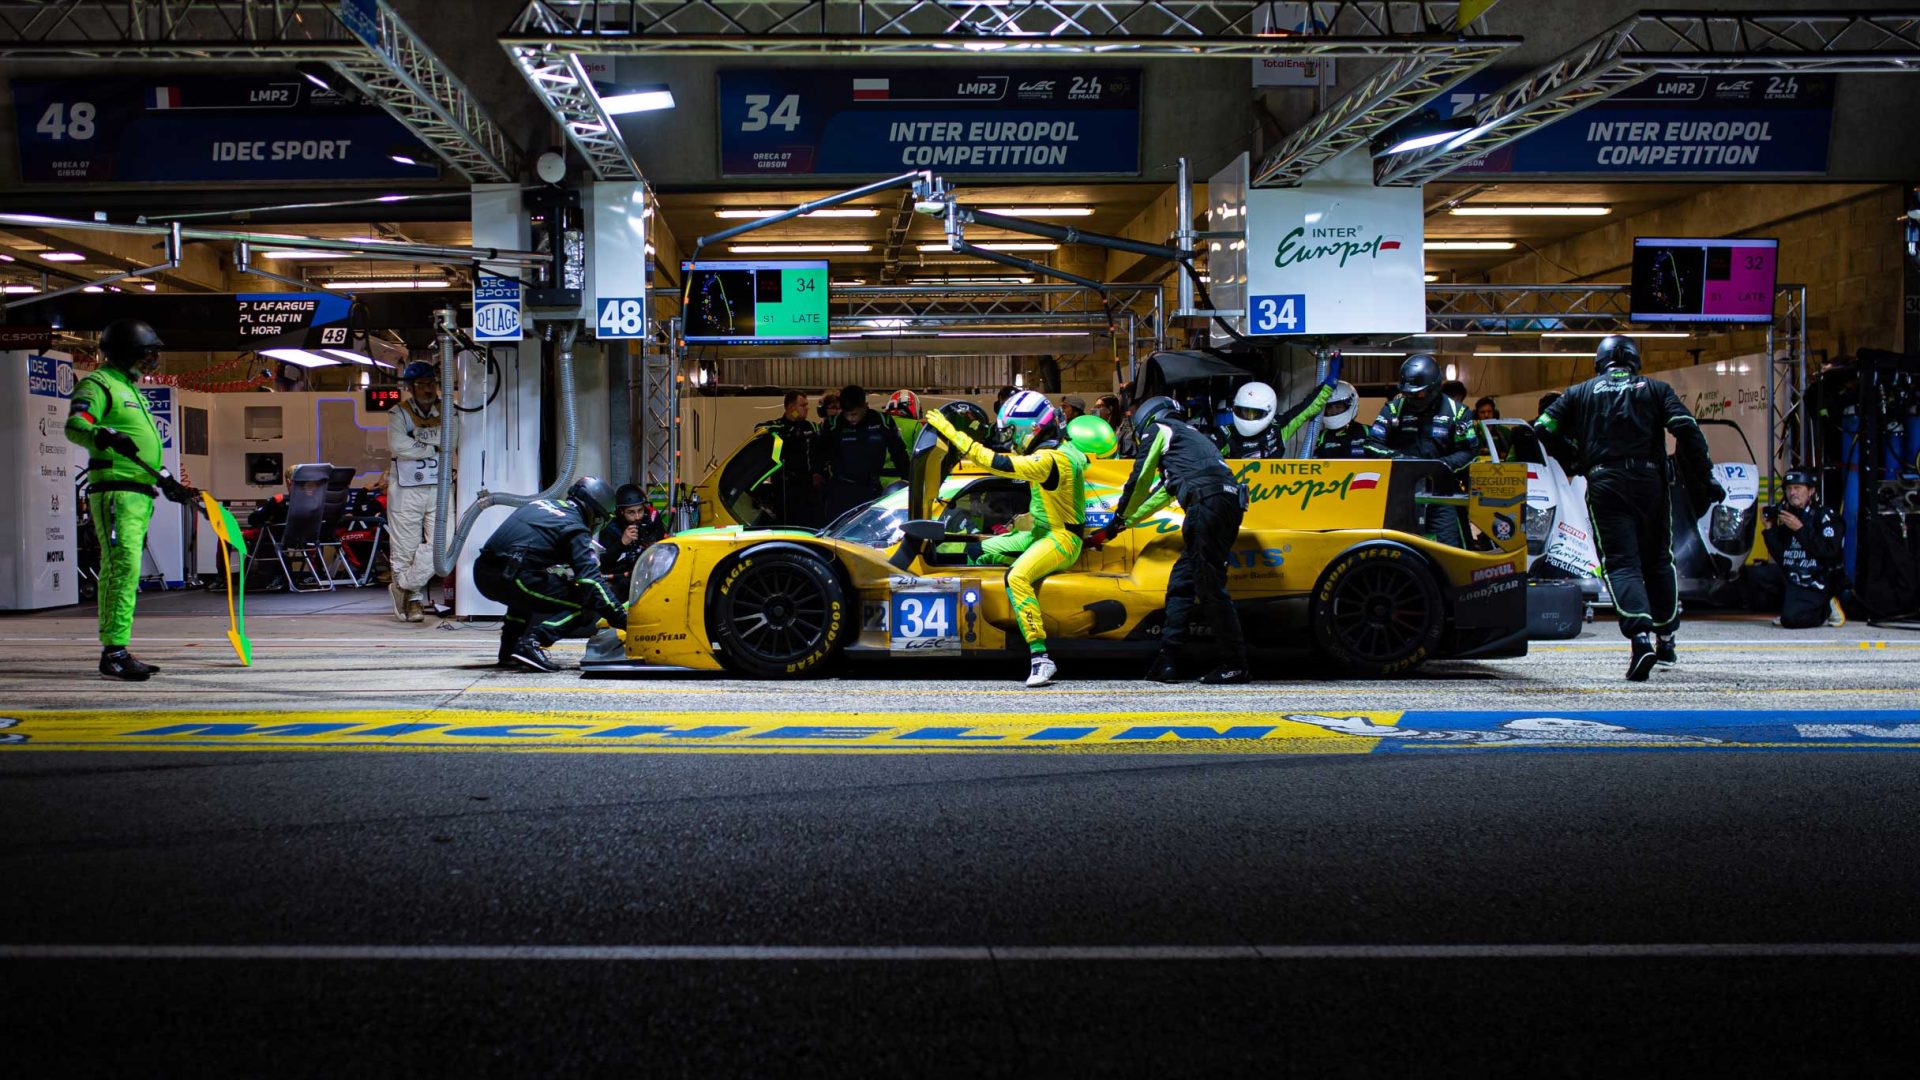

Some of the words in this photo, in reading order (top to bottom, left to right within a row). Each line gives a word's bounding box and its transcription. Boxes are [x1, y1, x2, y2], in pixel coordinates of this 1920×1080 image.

[1262, 59, 1329, 70] TotalEneis
[957, 83, 997, 95] LMP2
[1068, 76, 1102, 94] 24h
[1657, 82, 1696, 95] LMP2
[1765, 76, 1799, 94] 24h
[250, 90, 288, 102] LMP2
[741, 94, 800, 132] 34
[36, 102, 97, 140] 48
[889, 122, 963, 142] INTER
[968, 121, 1079, 142] EUROPOL
[1587, 121, 1661, 142] INTER
[1664, 121, 1773, 142] EUROPOL
[212, 141, 266, 161] IDEC
[271, 140, 352, 160] SPORT
[753, 153, 779, 161] ORECA
[781, 153, 792, 161] 07
[902, 145, 1068, 166] COMPETITION
[1597, 145, 1760, 165] COMPETITION
[757, 161, 787, 169] GIBSON
[57, 169, 87, 177] GIBSON
[1312, 228, 1357, 238] INTER
[1275, 227, 1382, 268] Europol
[1744, 256, 1764, 270] 32
[481, 278, 505, 288] DEC
[796, 278, 815, 292] 34
[476, 288, 519, 298] SPORT
[1738, 292, 1766, 301] LATE
[239, 302, 249, 311] P
[253, 301, 315, 311] LAFARGUE
[239, 314, 254, 323] PL
[258, 314, 302, 323] CHATIN
[477, 308, 518, 331] DELAGE
[600, 300, 643, 335] 48
[792, 314, 819, 323] LATE
[1258, 299, 1297, 330] 34
[240, 327, 247, 335] L
[251, 327, 282, 335] HORR
[324, 330, 346, 343] 48
[30, 361, 49, 375] IDEC
[31, 376, 57, 392] SPORT
[1738, 388, 1759, 404] Drive
[149, 400, 170, 409] ORT
[1270, 463, 1323, 476] INTER
[1725, 466, 1746, 478] P2
[1233, 461, 1354, 511] Europol
[47, 550, 65, 562] MOTUL
[1783, 550, 1806, 559] MEDIA
[721, 559, 753, 595] EAGLE
[1474, 565, 1513, 581] MOTUL
[1459, 580, 1519, 601] GOODYEAR
[864, 606, 886, 627] P2
[900, 598, 949, 638] 34
[634, 632, 687, 642] GOODYEAR
[786, 601, 841, 674] GOODYEAR
[906, 639, 945, 649] WEC
[118, 723, 1278, 741] MICHELIN
